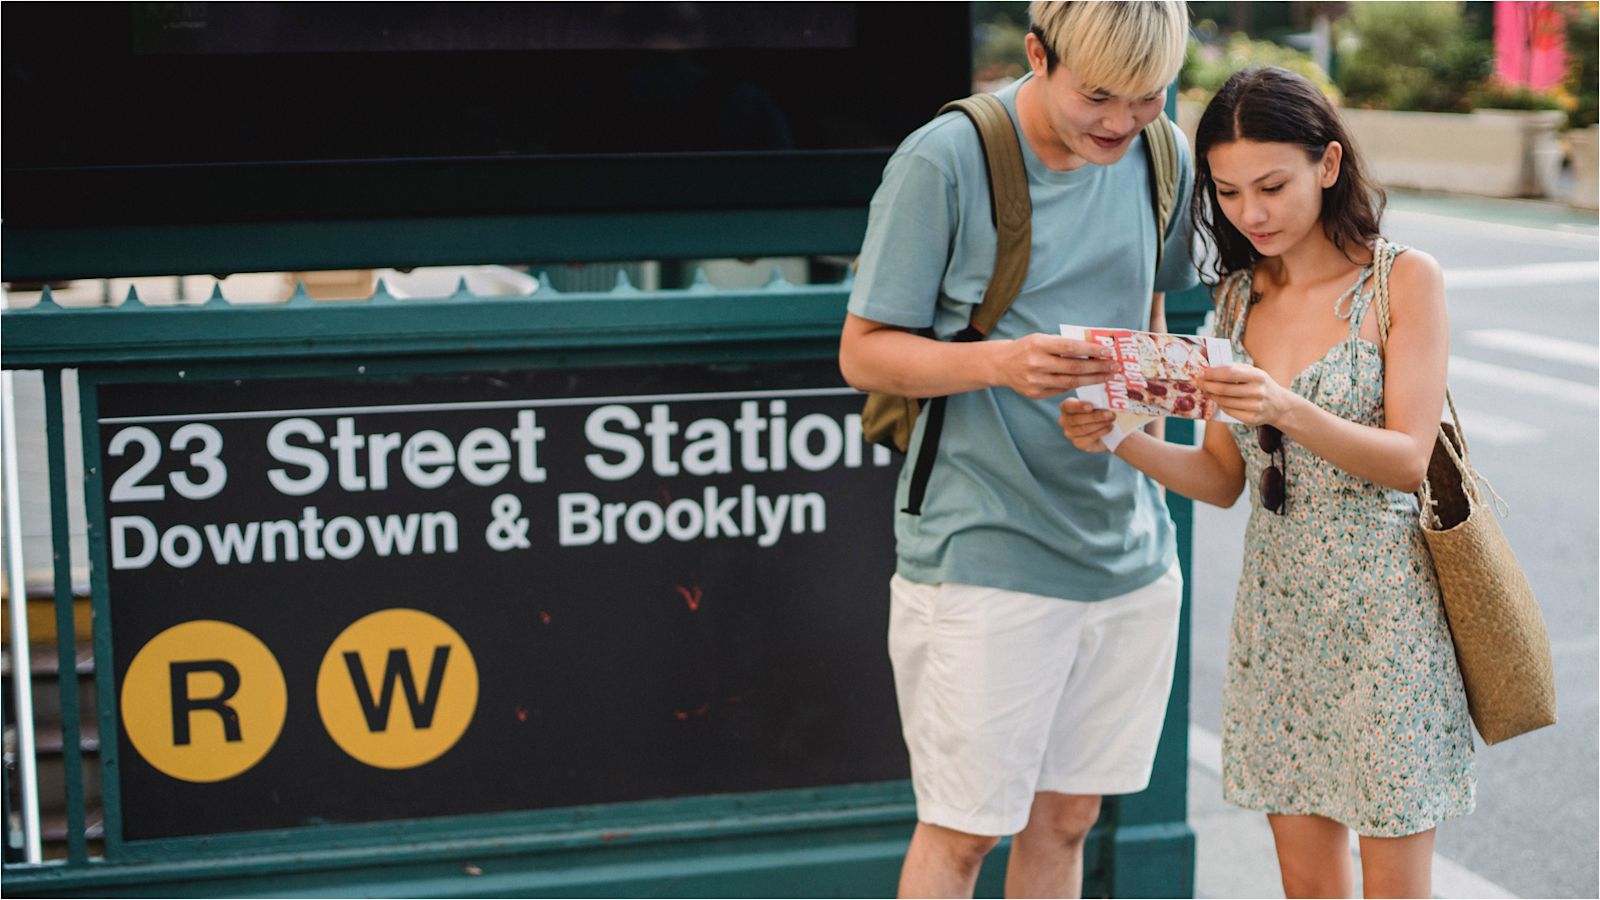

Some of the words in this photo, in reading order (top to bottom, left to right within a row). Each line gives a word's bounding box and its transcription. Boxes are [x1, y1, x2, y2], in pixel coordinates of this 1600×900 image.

[1117, 336, 1138, 360] THE
[1107, 379, 1131, 409] NYC
[108, 423, 227, 502] 23
[266, 409, 547, 496] Street
[584, 400, 892, 481] Station
[110, 506, 459, 570] Downtown
[485, 493, 531, 551] &
[558, 484, 826, 547] Brooklyn
[169, 659, 243, 746] R
[343, 645, 452, 733] W
